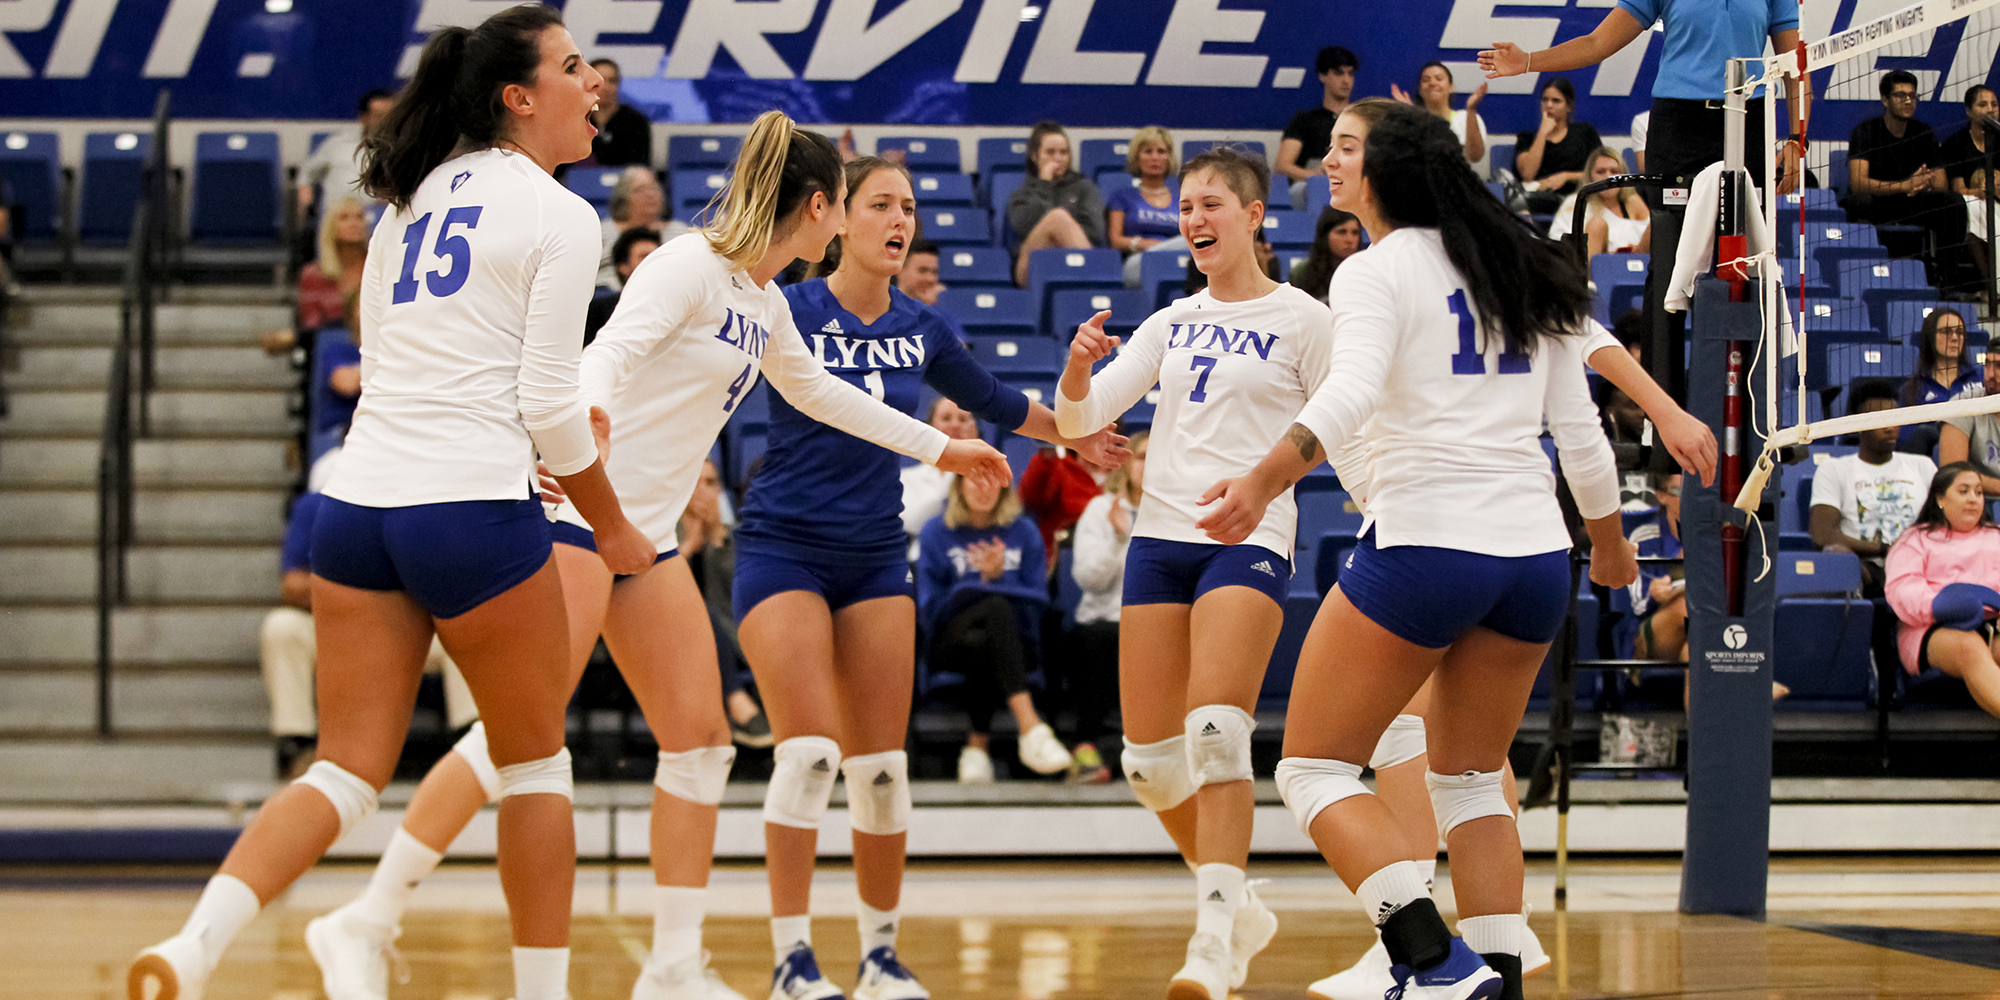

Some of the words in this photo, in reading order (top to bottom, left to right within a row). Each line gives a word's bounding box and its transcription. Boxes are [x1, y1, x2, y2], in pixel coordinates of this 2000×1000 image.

[392, 206, 484, 305] 15
[810, 334, 926, 369] LYNN
[1168, 323, 1280, 361] LYNN
[723, 363, 752, 413] 4
[864, 370, 885, 403] 1
[1189, 355, 1218, 403] 7
